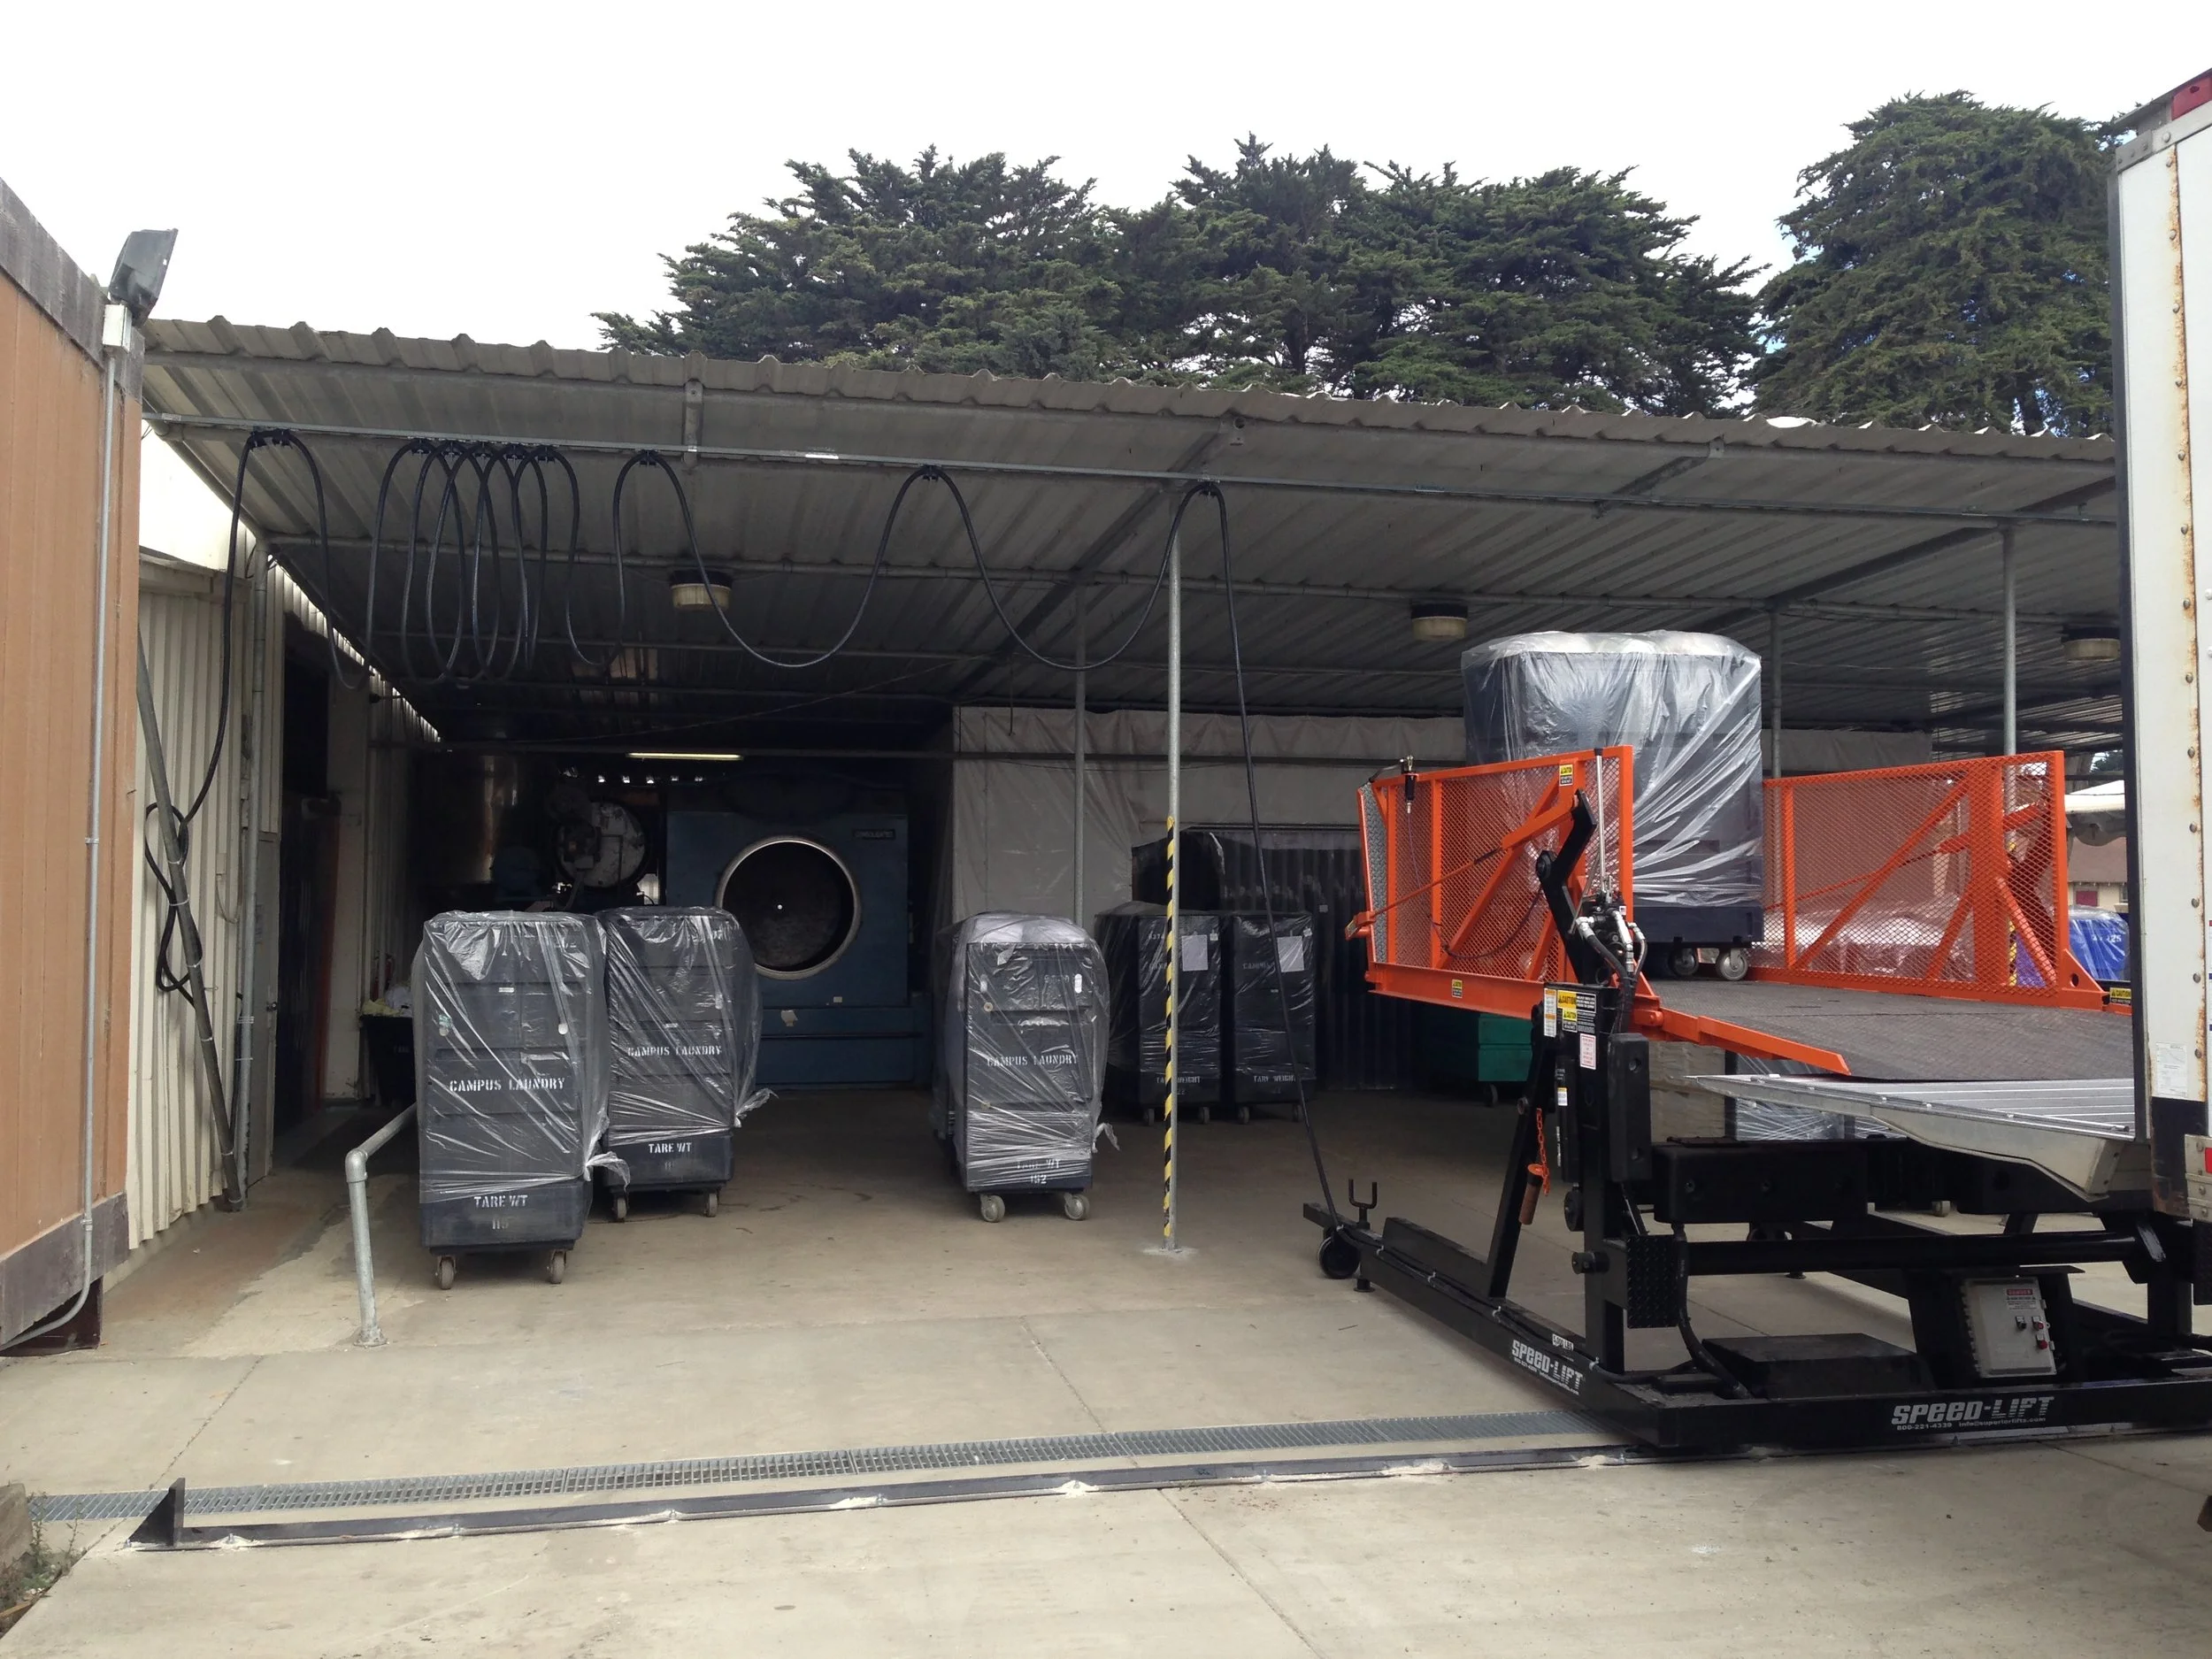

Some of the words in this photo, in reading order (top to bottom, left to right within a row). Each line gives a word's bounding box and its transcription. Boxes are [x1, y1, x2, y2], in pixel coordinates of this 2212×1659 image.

[627, 1046, 671, 1056] CAMPUS
[675, 1045, 723, 1056] LAUNDRY
[987, 1056, 1028, 1067] CAMPUS
[1033, 1054, 1078, 1066] LAUNDRY
[449, 1079, 502, 1093] CAMPUS
[509, 1077, 565, 1091] LAUNDRY
[648, 1142, 674, 1154] TARE
[676, 1141, 693, 1153] WT
[1046, 1158, 1061, 1169] WT
[473, 1194, 506, 1208] TARE
[509, 1194, 528, 1208] WT
[1896, 1422, 1953, 1432] 800-221-4339
